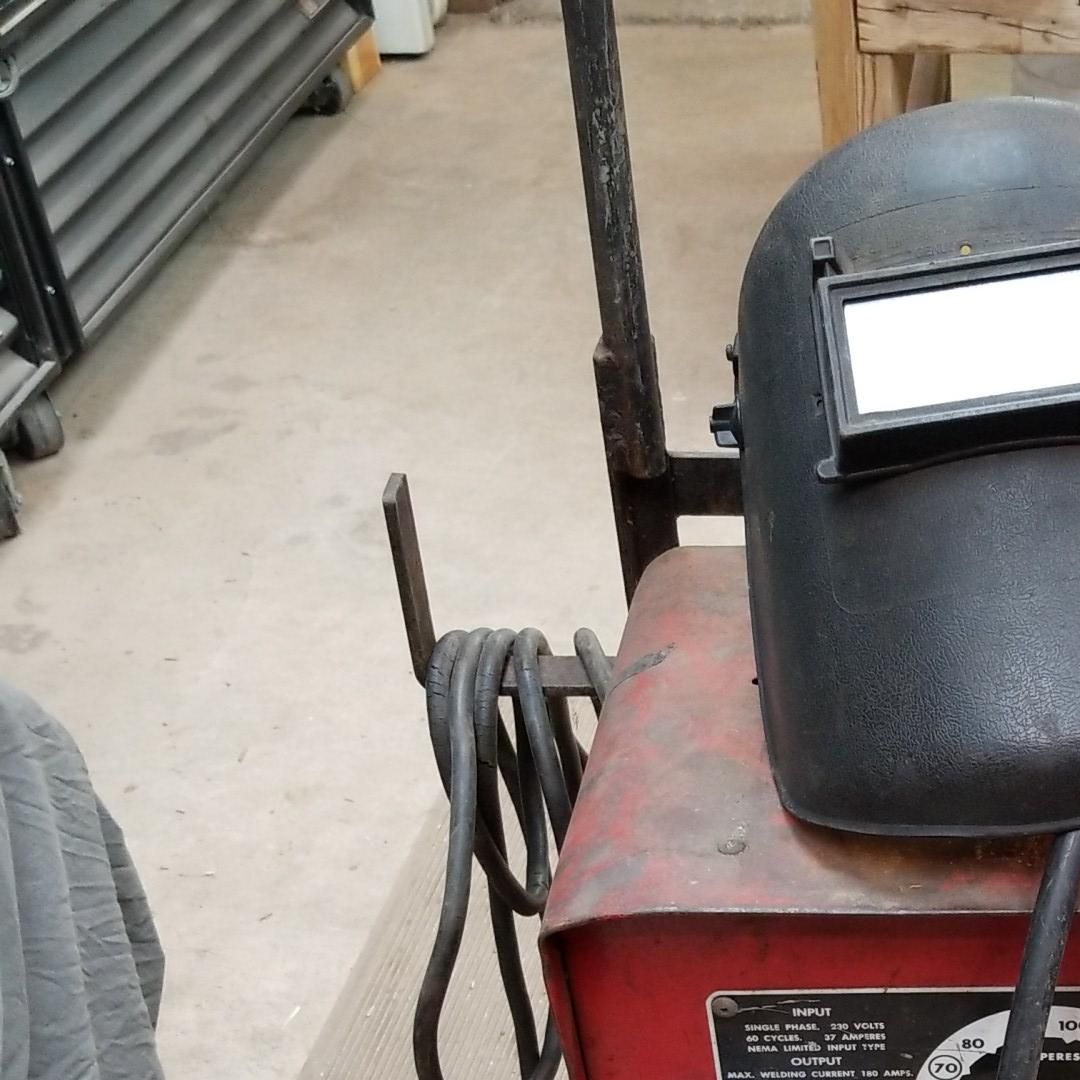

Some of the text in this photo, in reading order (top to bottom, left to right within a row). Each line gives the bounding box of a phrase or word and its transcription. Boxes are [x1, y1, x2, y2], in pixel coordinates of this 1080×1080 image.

[792, 1007, 832, 1017] INPUT
[744, 1023, 781, 1032] SINGLE
[830, 1022, 849, 1031] 230
[853, 1022, 885, 1030] VOLTS
[746, 1034, 759, 1042] 60
[824, 1033, 836, 1042] 37
[841, 1033, 886, 1041] AMPERES
[747, 1043, 886, 1053] NEMA LIMITED INPUT TYPE
[962, 1038, 985, 1049] 80
[790, 1056, 842, 1066] OUTPUT
[1040, 1052, 1080, 1061] PERES
[933, 1063, 958, 1074] 70
[727, 1069, 914, 1080] MAX. WELDING CURRENT 180 AMPS.
